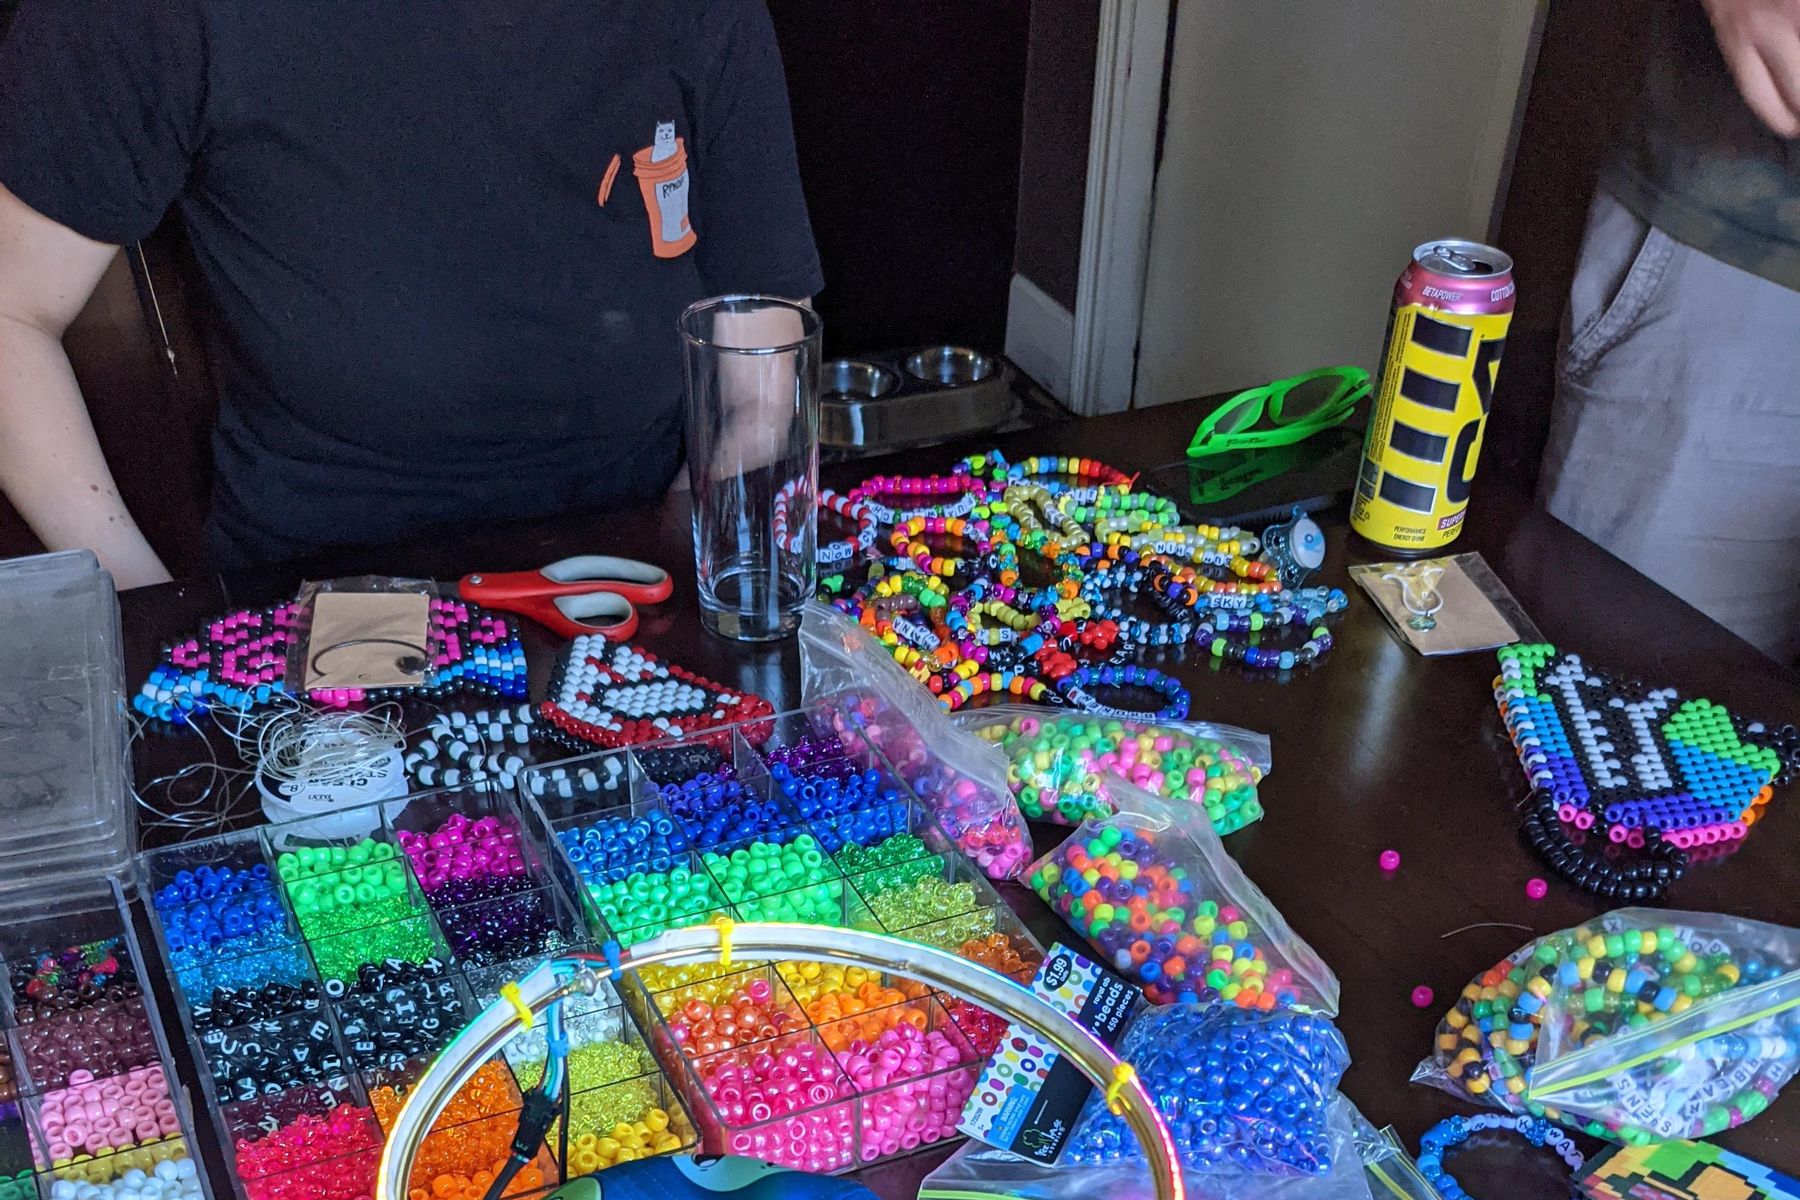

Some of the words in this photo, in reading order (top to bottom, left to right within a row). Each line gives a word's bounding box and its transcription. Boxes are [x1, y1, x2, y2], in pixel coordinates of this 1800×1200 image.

[1211, 596, 1246, 608] SKY
[1046, 957, 1068, 986] $1.99
[1093, 987, 1106, 1005] royal
[1102, 976, 1111, 987] ab
[1106, 1017, 1119, 1032] 450
[1115, 989, 1134, 1018] pieces
